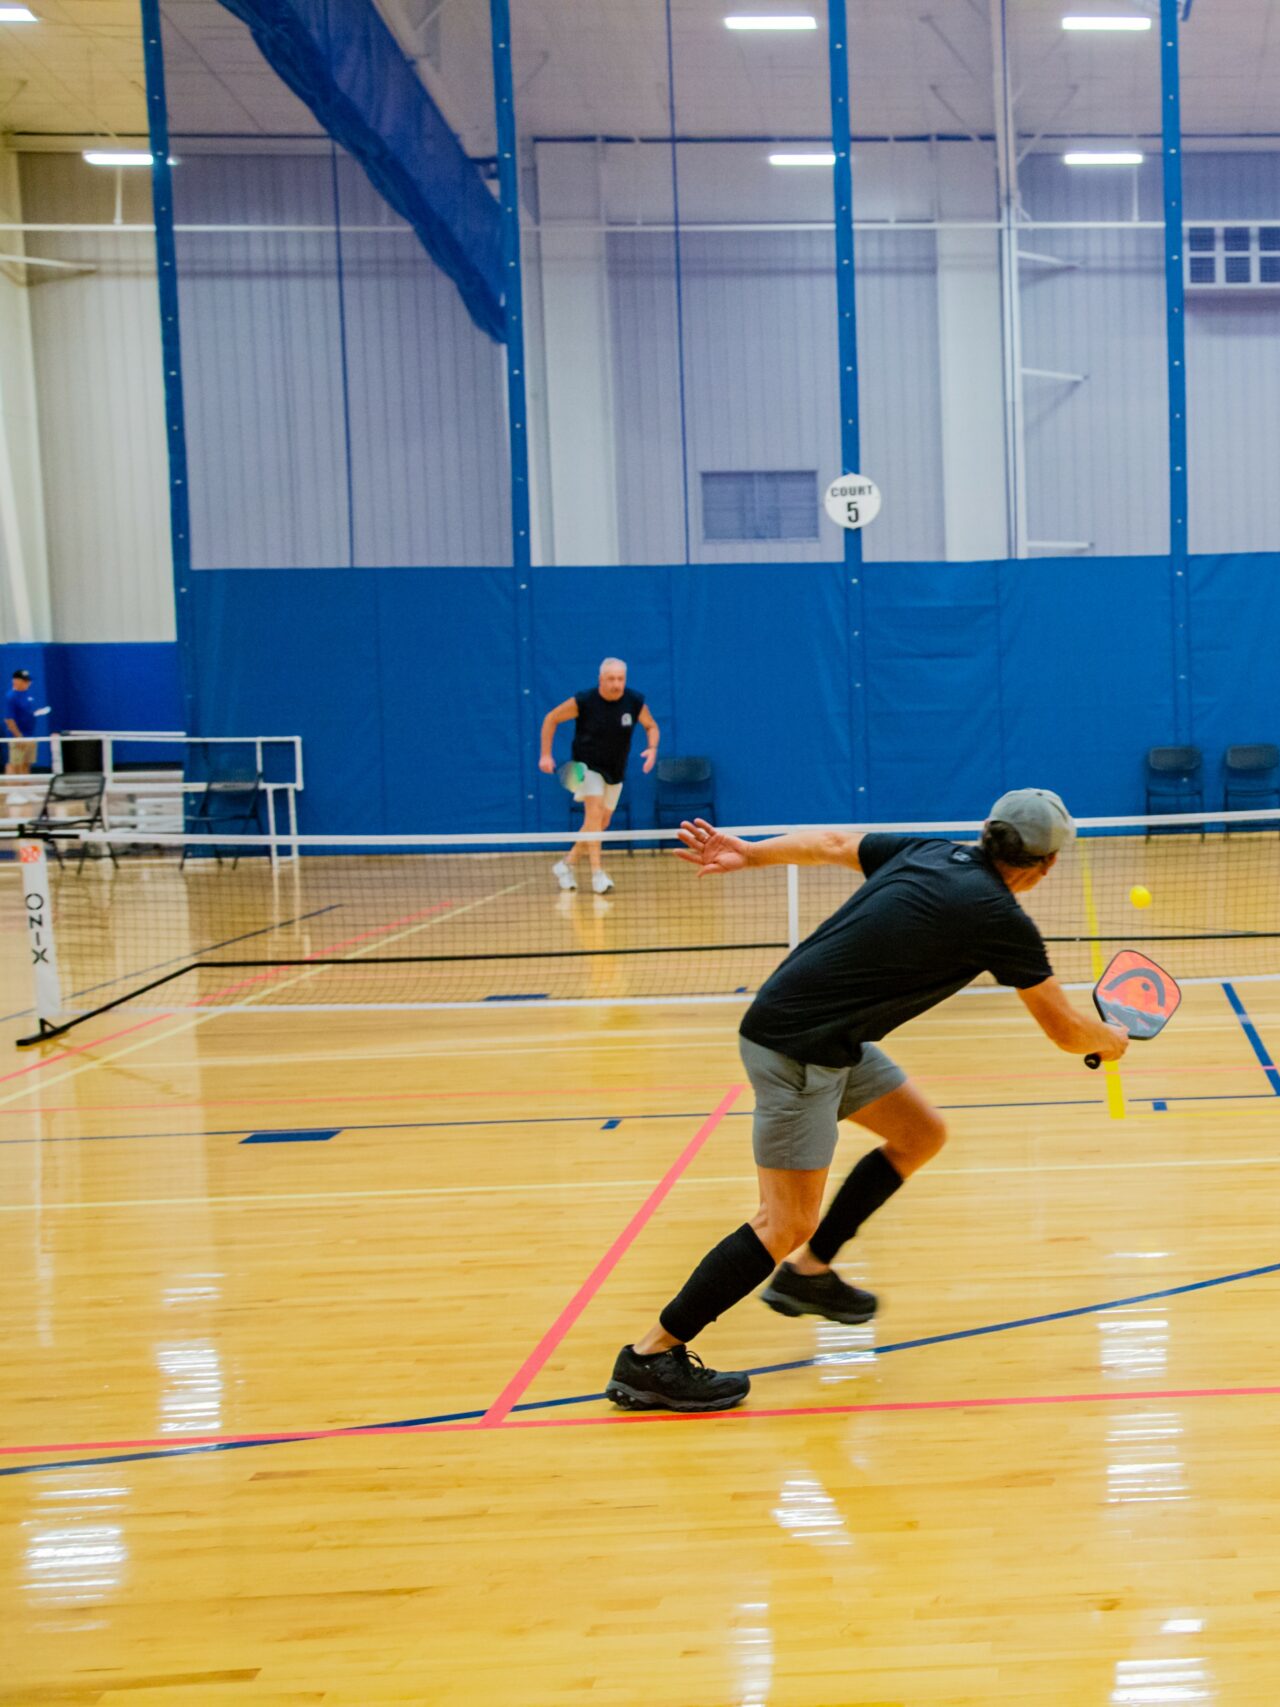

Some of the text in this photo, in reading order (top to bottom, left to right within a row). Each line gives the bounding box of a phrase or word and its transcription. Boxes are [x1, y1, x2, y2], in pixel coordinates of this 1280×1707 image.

[831, 485, 872, 497] COURT
[847, 501, 859, 523] 5
[25, 893, 49, 964] ONIX
